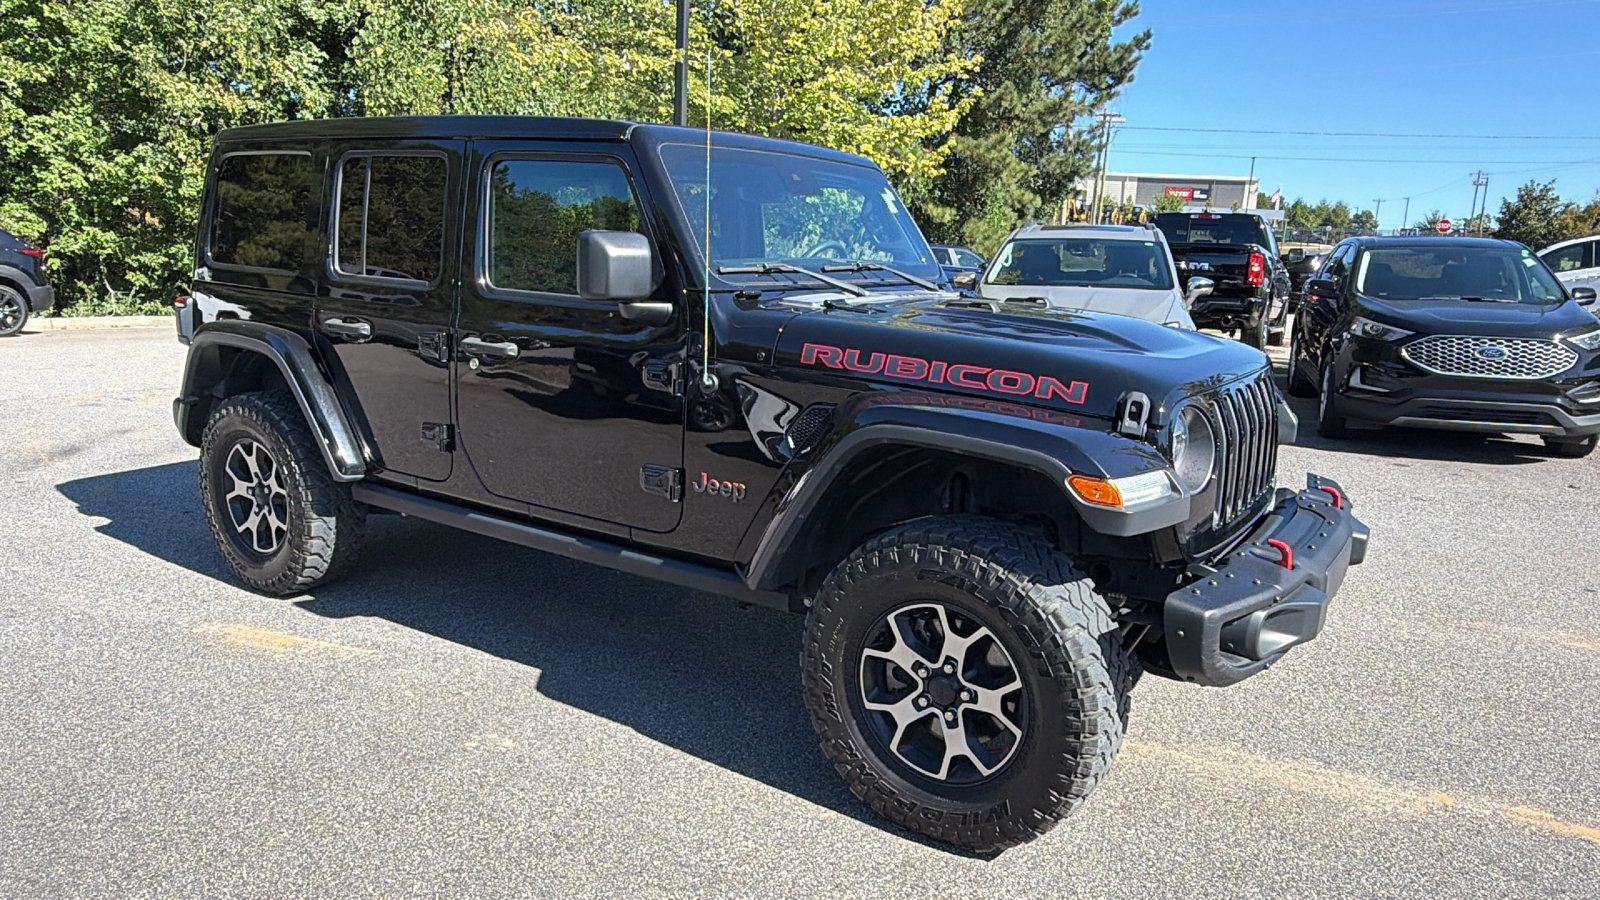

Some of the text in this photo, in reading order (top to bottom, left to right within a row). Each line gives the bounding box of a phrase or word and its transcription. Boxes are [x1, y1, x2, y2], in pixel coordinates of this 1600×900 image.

[1437, 222, 1451, 230] STOP
[801, 343, 1089, 404] RUBICON
[692, 471, 746, 503] Jeep
[818, 653, 1011, 828] WILDPEAK M/T
